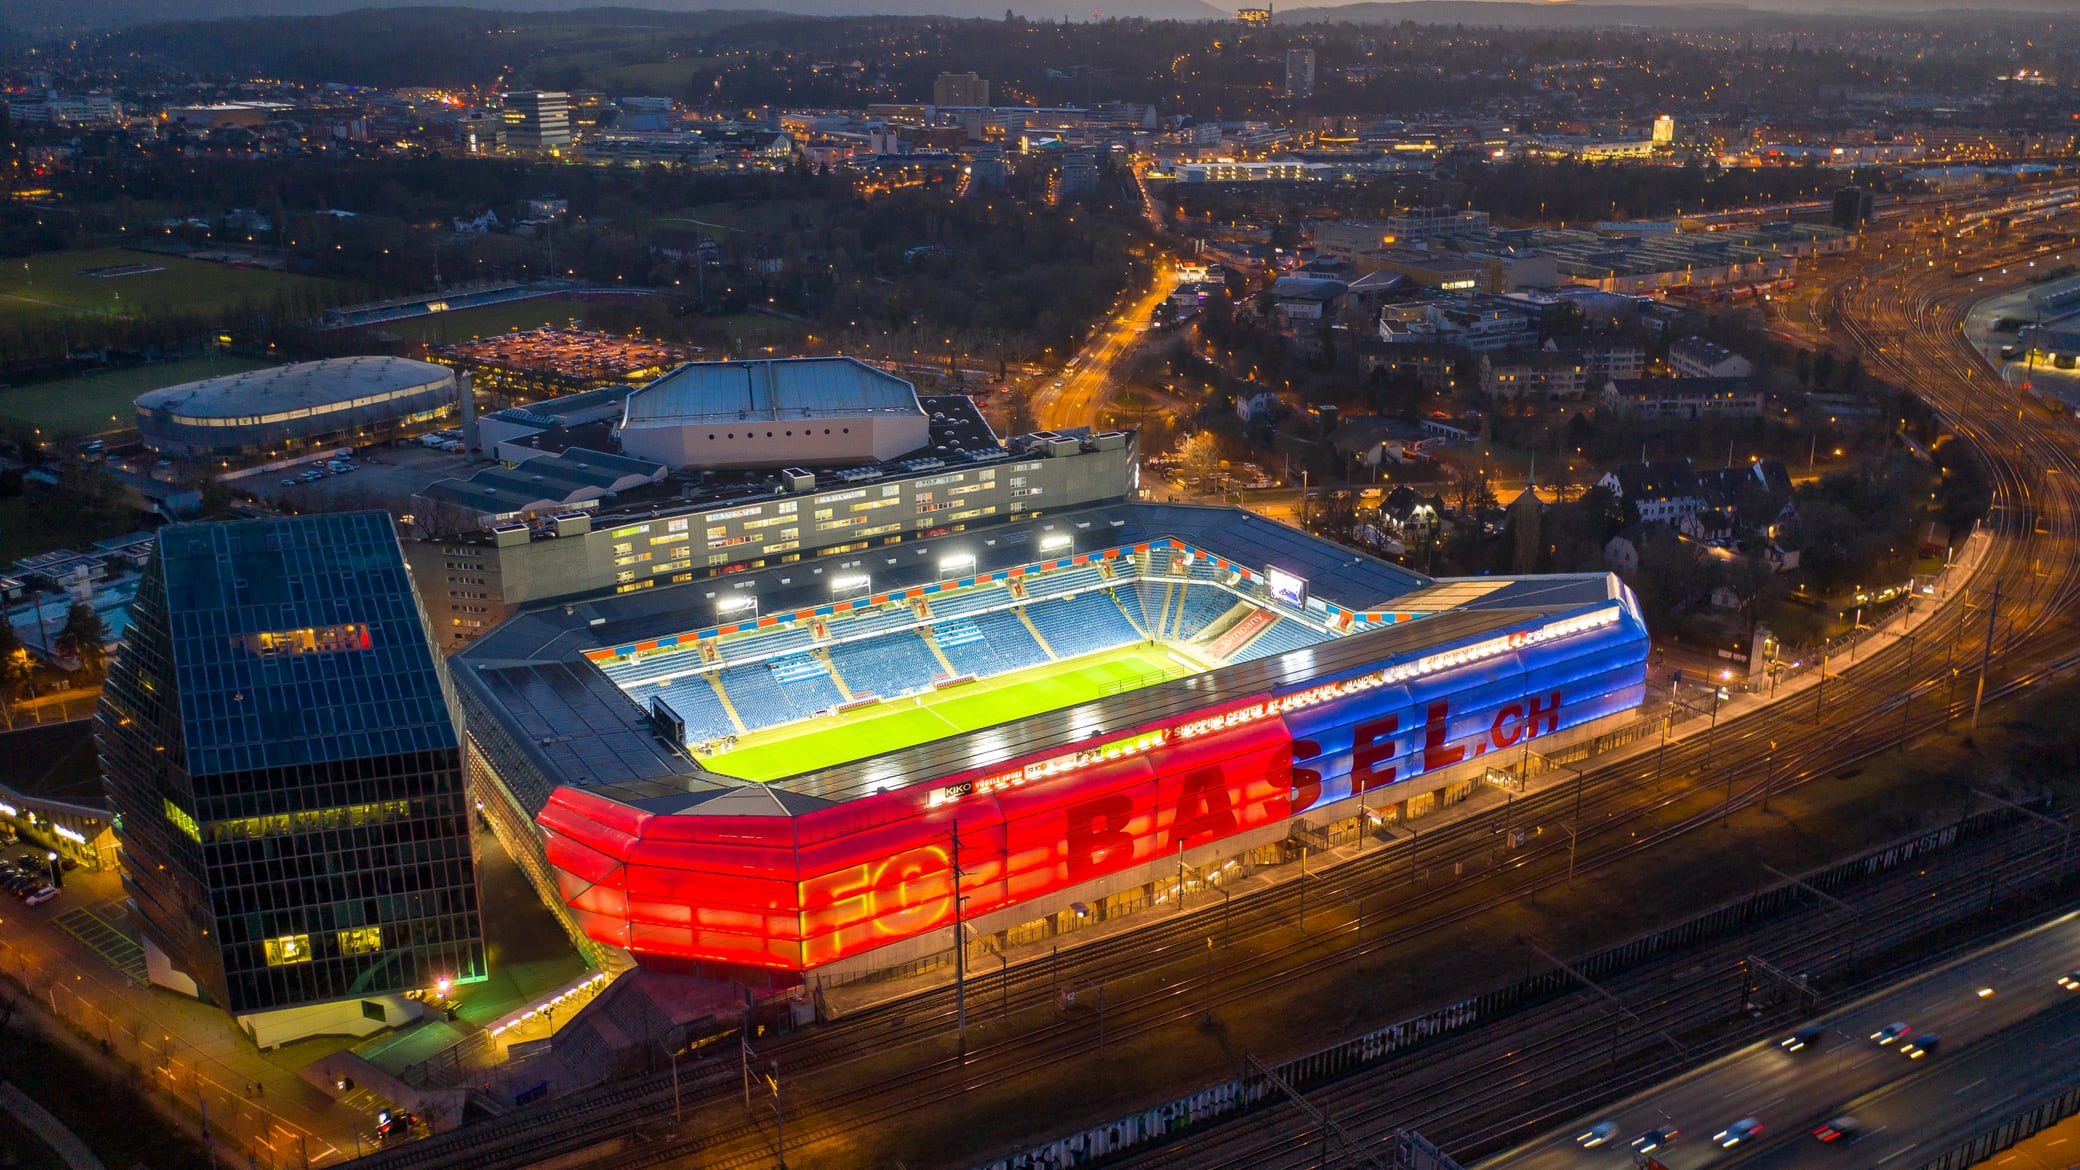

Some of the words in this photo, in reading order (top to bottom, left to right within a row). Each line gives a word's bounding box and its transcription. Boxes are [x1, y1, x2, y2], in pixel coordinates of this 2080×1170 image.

[1219, 612, 1263, 650] sympany
[1346, 674, 1374, 688] MANOR
[1174, 715, 1224, 738] SHOPPING
[1226, 704, 1264, 727] CENTER
[1267, 699, 1280, 714] ST.
[1281, 684, 1338, 709] JAKOB-PARK
[975, 776, 999, 789] VÖGELE
[1002, 770, 1023, 782] SHOES
[946, 783, 971, 796] KIKO
